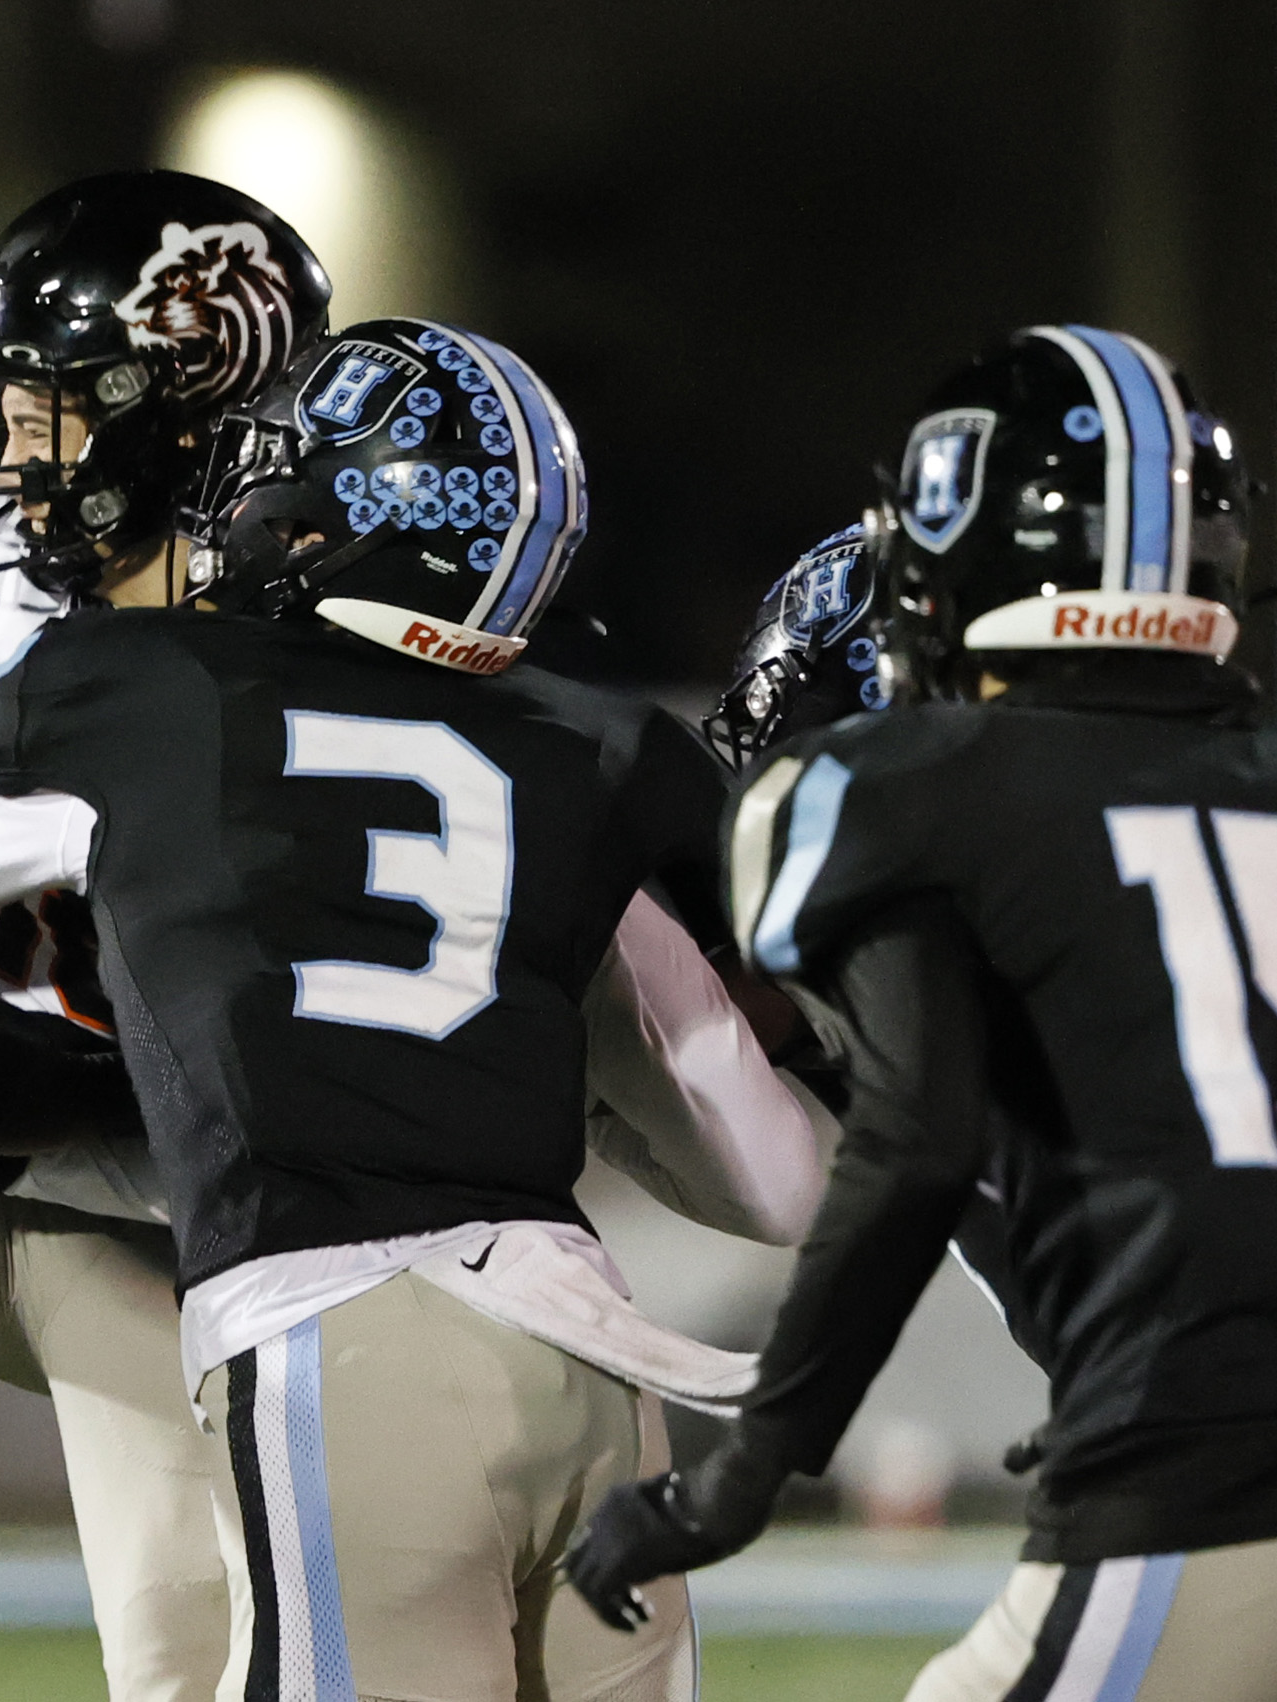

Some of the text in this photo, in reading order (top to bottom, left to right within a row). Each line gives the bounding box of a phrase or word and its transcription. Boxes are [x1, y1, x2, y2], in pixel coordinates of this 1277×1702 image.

[309, 354, 395, 427] H
[338, 343, 417, 376] HUSKIES
[793, 555, 857, 629] H
[400, 621, 525, 672] Riddel
[282, 709, 516, 1042] 3
